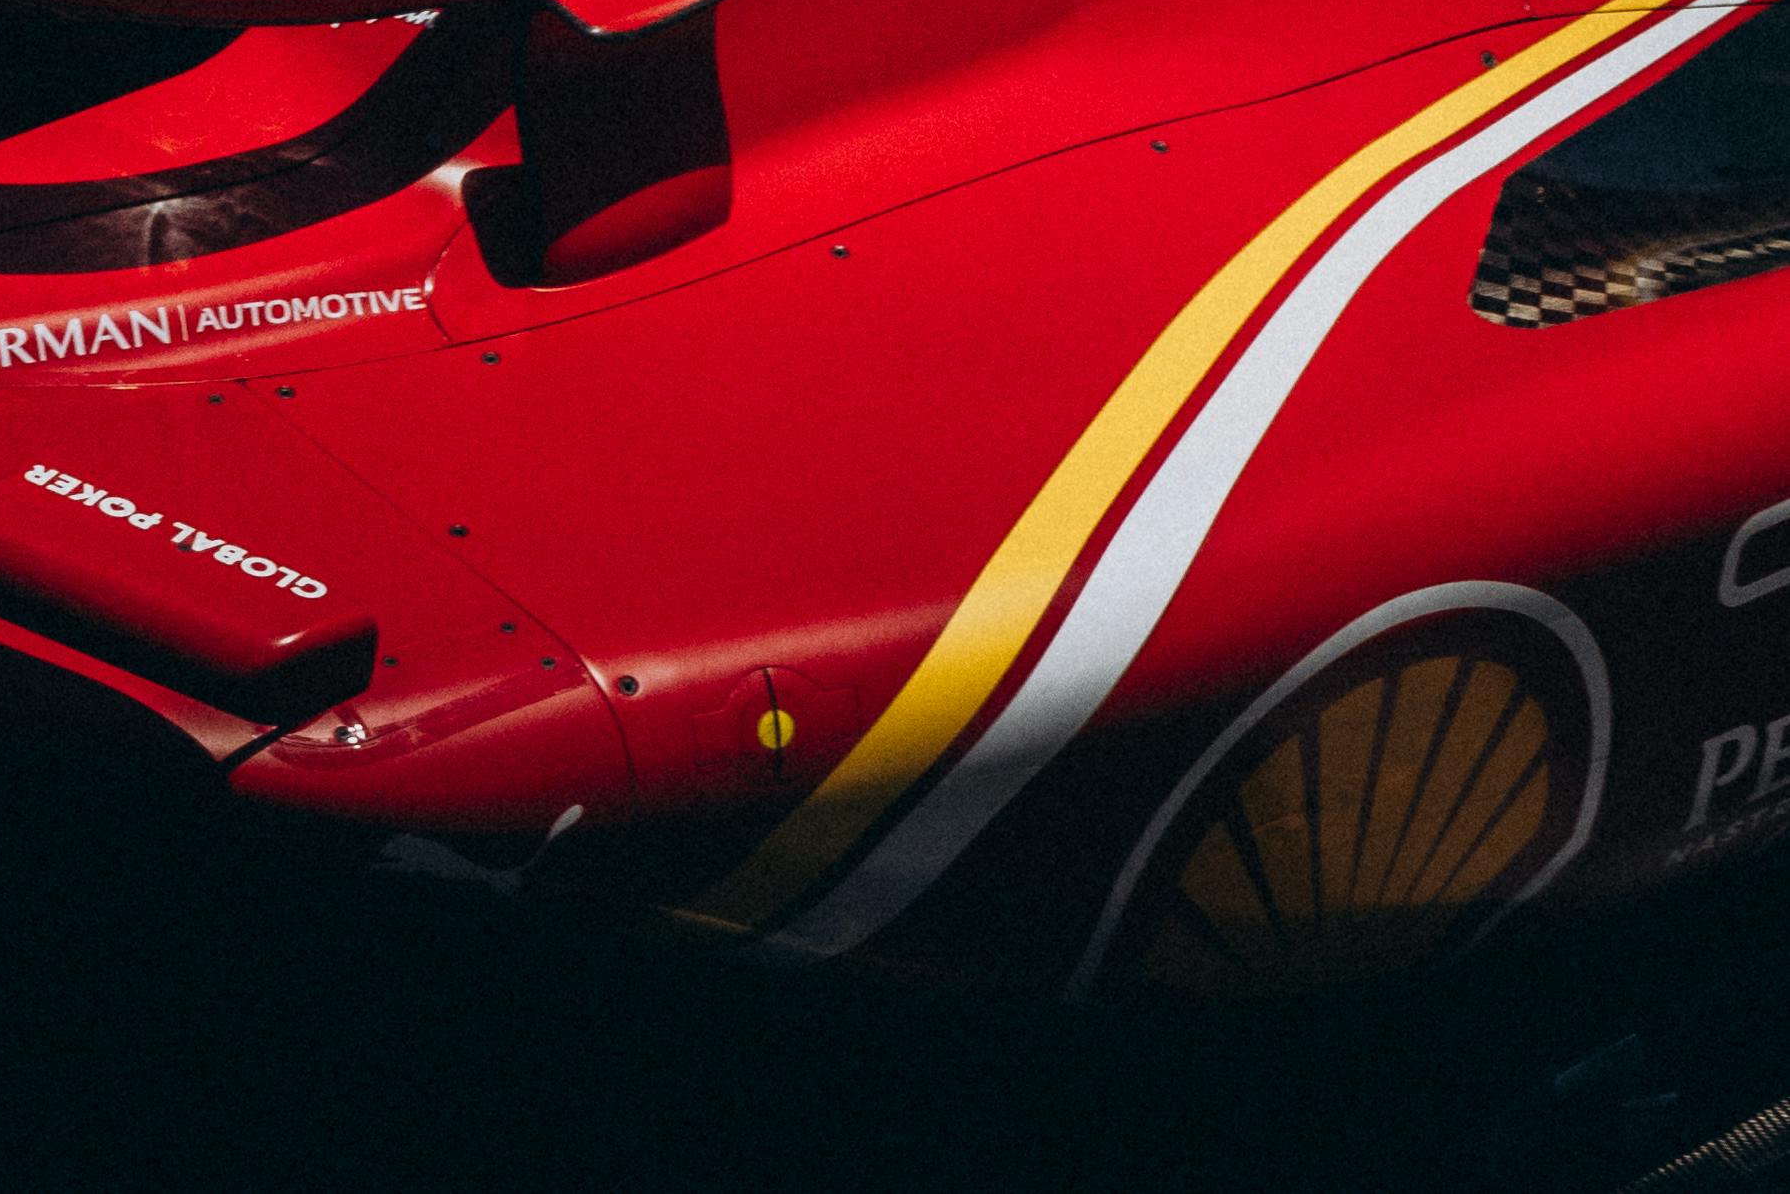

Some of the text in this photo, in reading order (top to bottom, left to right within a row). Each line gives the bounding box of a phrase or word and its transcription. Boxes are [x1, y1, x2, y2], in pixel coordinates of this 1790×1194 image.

[195, 287, 428, 334] AUTOMOTIVE
[23, 463, 328, 599] GLOBAL POKER
